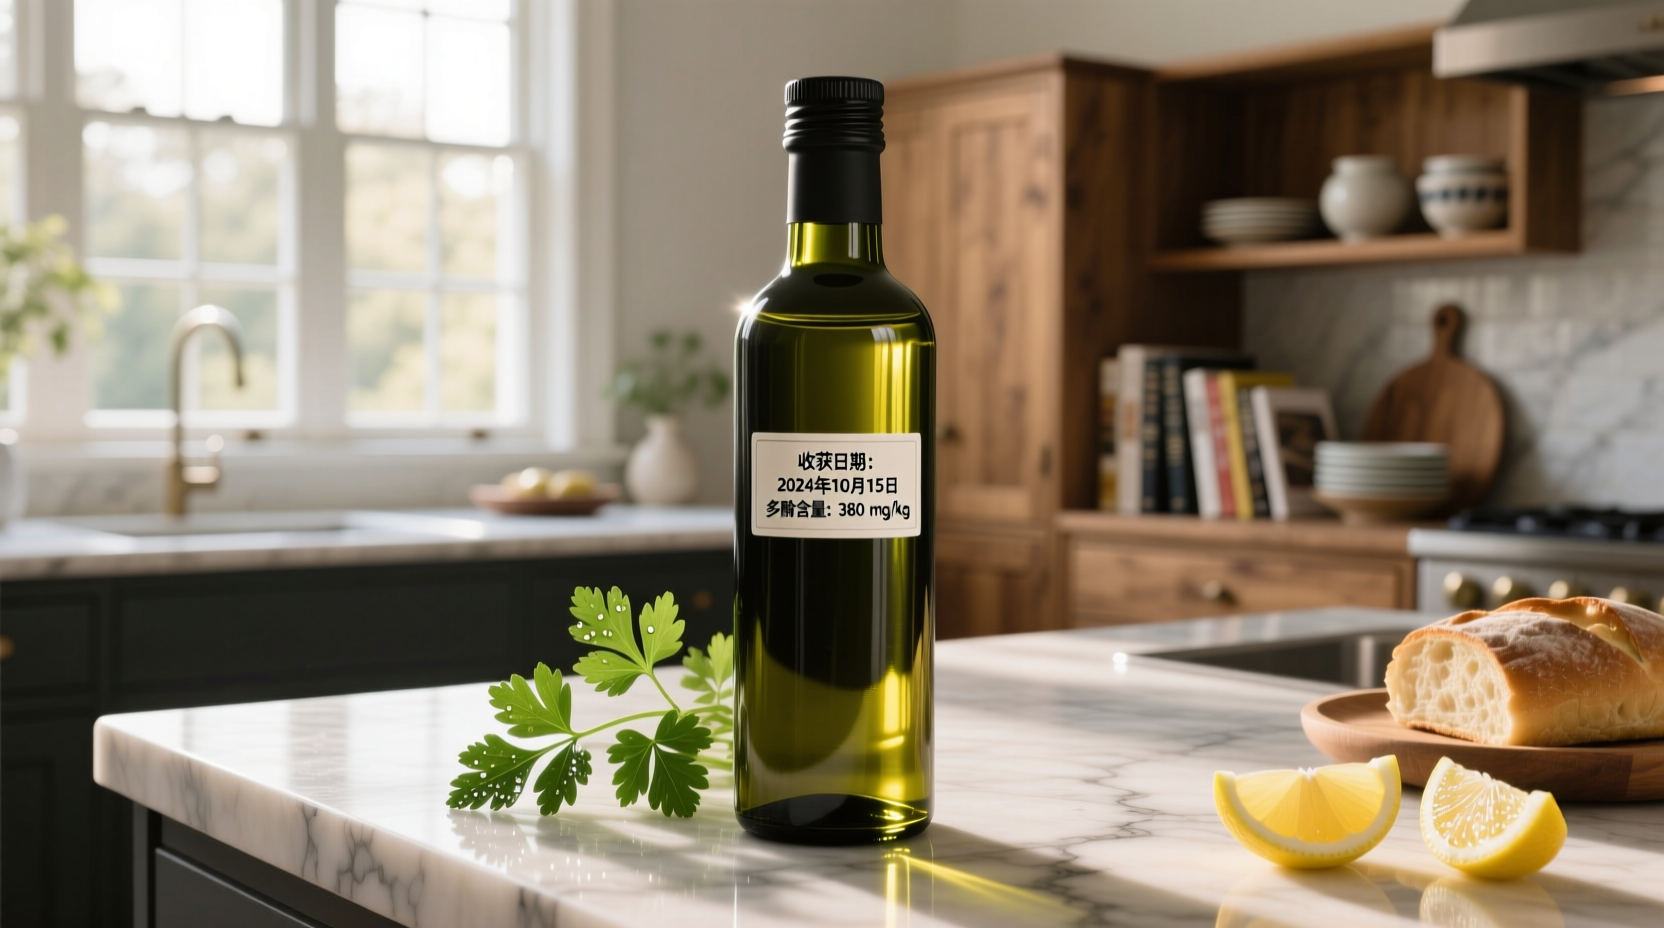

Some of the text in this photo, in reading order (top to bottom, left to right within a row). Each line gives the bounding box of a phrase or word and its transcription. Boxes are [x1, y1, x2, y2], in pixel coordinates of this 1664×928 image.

[798, 451, 873, 471] 收获日期：
[777, 475, 898, 495] 2024年10月15日
[838, 502, 865, 517] 380
[869, 500, 910, 521] mg/kg
